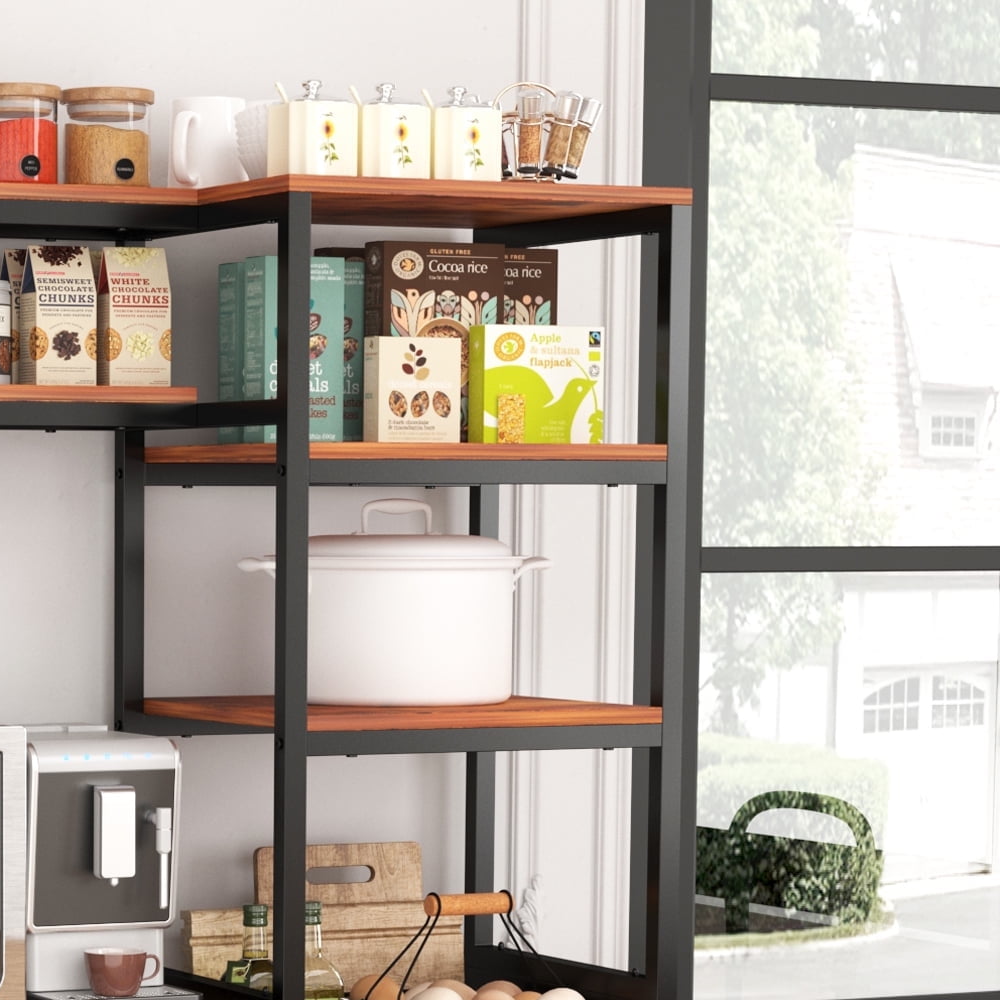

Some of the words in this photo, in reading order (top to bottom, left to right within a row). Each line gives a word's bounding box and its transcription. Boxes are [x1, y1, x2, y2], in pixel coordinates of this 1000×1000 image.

[428, 259, 465, 273] Cocoa
[467, 260, 489, 274] rice
[521, 265, 542, 279] rice
[36, 277, 93, 285] SEMISWEET
[110, 277, 151, 286] WHITE
[39, 293, 95, 303] CHUNKS
[112, 294, 169, 304] CHUNKS
[530, 333, 562, 344] Apple
[541, 346, 580, 355] sultana
[530, 357, 573, 369] flapjack
